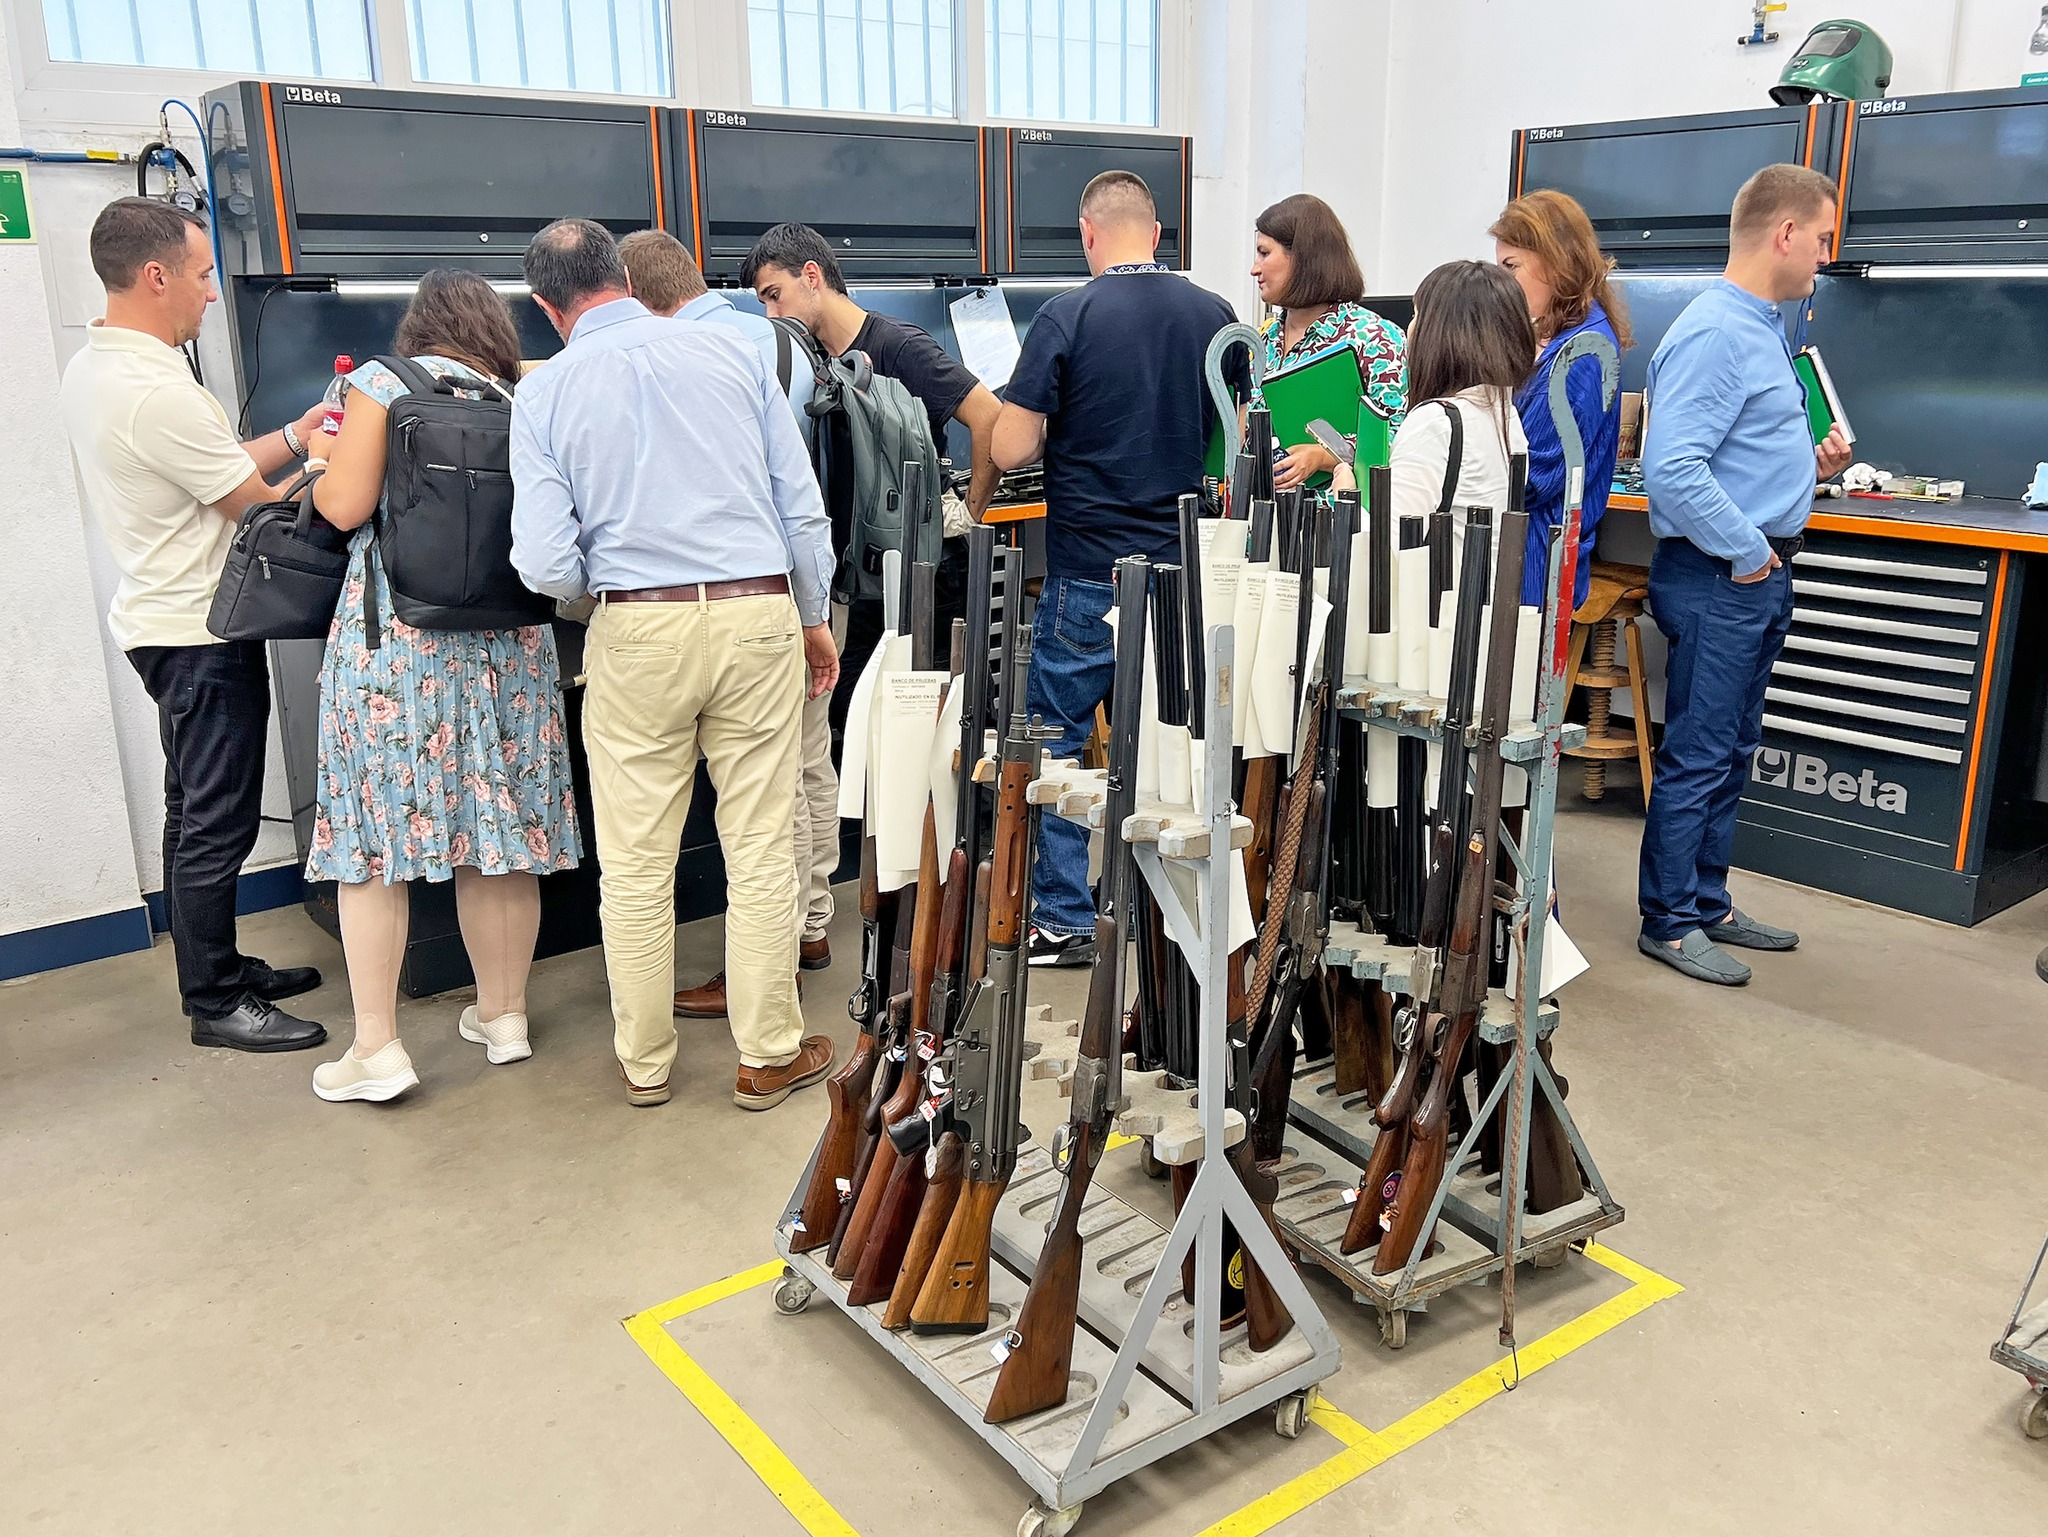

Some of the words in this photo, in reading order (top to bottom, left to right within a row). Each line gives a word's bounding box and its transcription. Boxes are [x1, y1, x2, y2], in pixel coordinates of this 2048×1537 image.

[301, 87, 341, 104] Beta
[1872, 100, 1906, 113] Beta
[717, 112, 747, 126] Beta
[1030, 130, 1052, 141] Beta
[1540, 128, 1563, 140] Beta
[1793, 753, 1907, 815] Beta
